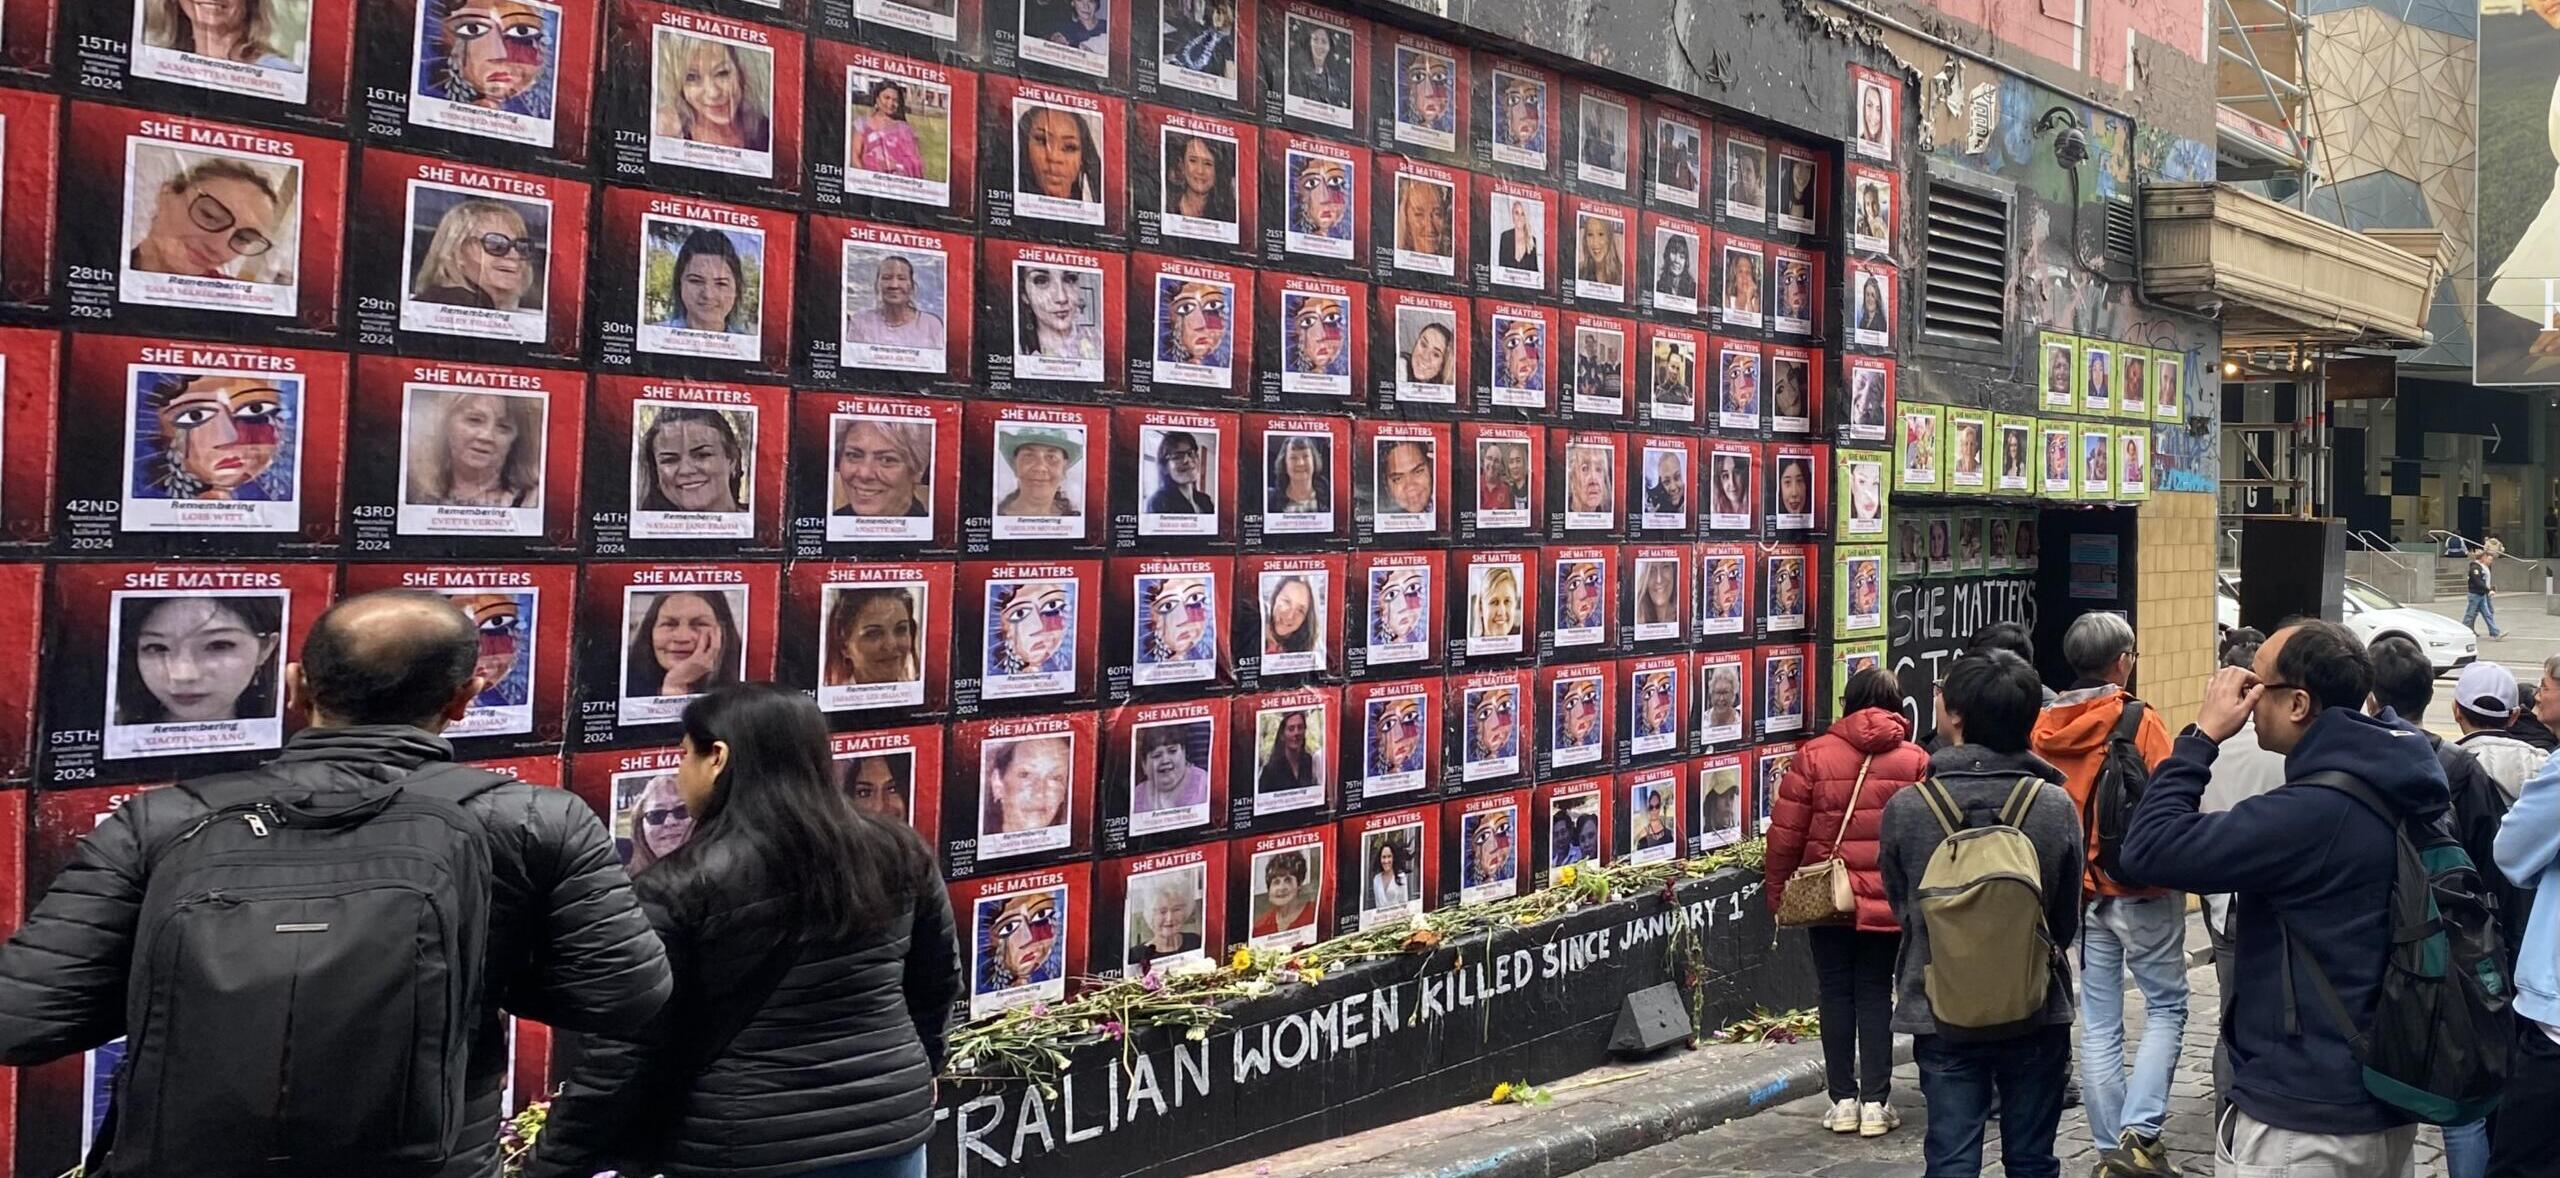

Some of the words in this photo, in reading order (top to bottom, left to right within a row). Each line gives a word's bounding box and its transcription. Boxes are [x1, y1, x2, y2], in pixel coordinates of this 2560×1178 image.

[661, 12, 692, 29] SHE
[696, 18, 768, 44] MATTERS
[78, 35, 127, 54] 15TH
[180, 54, 263, 77] Remembering
[854, 53, 881, 69] SHE
[884, 59, 946, 83] MATTERS
[81, 74, 124, 90] 2024
[366, 86, 407, 103] 16TH
[1018, 86, 1041, 99] SHE
[1044, 91, 1098, 110] MATTERS
[450, 103, 518, 123] Remembering
[368, 123, 402, 137] 2024
[1166, 115, 1185, 127] SHE
[1188, 120, 1234, 136] MATTERS
[141, 120, 187, 140] SHE
[190, 126, 294, 156] MATTERS
[614, 130, 647, 144] 17TH
[1290, 140, 1309, 151] SHE
[1311, 144, 1351, 159] MATTERS
[617, 164, 645, 175] 2024
[814, 163, 842, 176] 18TH
[1399, 162, 1417, 173] SHE
[1419, 165, 1452, 180] MATTERS
[418, 165, 453, 182] SHE
[460, 171, 545, 196] MATTERS
[817, 193, 841, 205] 2024
[987, 189, 1012, 200] 19TH
[651, 200, 681, 216] SHE
[686, 205, 759, 227] MATTERS
[850, 227, 876, 241] SHE
[880, 231, 942, 249] MATTERS
[1018, 249, 1041, 261] SHE
[1044, 253, 1099, 267] MATTERS
[69, 266, 113, 281] 28th
[1161, 263, 1179, 274] SHE
[1184, 269, 1231, 282] MATTERS
[1286, 280, 1304, 290] SHE
[1307, 282, 1346, 295] MATTERS
[359, 297, 395, 310] 29th
[1400, 296, 1415, 305] SHE
[1418, 298, 1453, 309] MATTERS
[70, 305, 112, 318] 2024
[441, 306, 509, 320] Remembering
[602, 322, 633, 334] 30th
[359, 332, 393, 344] 2024
[141, 348, 184, 364] SHE
[188, 351, 295, 371] MATTERS
[603, 354, 631, 365] 2024
[414, 368, 450, 383] SHE
[456, 372, 541, 389] MATTERS
[642, 385, 673, 399] SHE
[678, 389, 751, 403] MATTERS
[837, 401, 863, 414] SHE
[867, 403, 931, 417] MATTERS
[1000, 409, 1024, 420] SHE
[1027, 410, 1082, 423] MATTERS
[1145, 414, 1165, 424] SHE
[1167, 416, 1216, 427] MATTERS
[1268, 420, 1286, 430] SHE
[1289, 421, 1329, 432] MATTERS
[1378, 426, 1394, 435] SHE
[1396, 426, 1432, 436] MATTERS
[66, 500, 119, 512] 42ND
[171, 502, 255, 512] Remembering
[352, 506, 395, 517] 43RD
[438, 508, 506, 517] Remembering
[213, 513, 244, 521] WITT
[593, 513, 628, 523] 44TH
[664, 514, 722, 522] Remembering
[795, 518, 824, 527] 45TH
[965, 518, 991, 526] 46TH
[72, 539, 114, 549] 2024
[356, 540, 391, 550] 2024
[596, 544, 625, 554] 2024
[1472, 554, 1486, 563] SHE
[1488, 553, 1521, 562] MATTERS
[1560, 550, 1571, 558] SHE
[1574, 549, 1603, 558] MATTERS
[1140, 562, 1160, 573] SHE
[1163, 562, 1211, 572] MATTERS
[1264, 561, 1281, 570] SHE
[1284, 560, 1325, 569] MATTERS
[1372, 557, 1388, 566] SHE
[1390, 556, 1427, 565] MATTERS
[402, 573, 438, 585] SHE
[445, 572, 532, 585] MATTERS
[633, 570, 663, 584] SHE
[669, 570, 742, 583] MATTERS
[829, 570, 854, 581] SHE
[858, 569, 923, 580] MATTERS
[992, 566, 1014, 578] SHE
[1018, 566, 1074, 577] MATTERS
[125, 573, 169, 587] SHE
[178, 573, 281, 587] MATTERS
[1892, 585, 1946, 647] SHE
[1556, 670, 1569, 679] SHE
[1571, 667, 1601, 676] MATTERS
[1468, 678, 1481, 687] SHE
[1484, 674, 1518, 685] MATTERS
[1369, 687, 1385, 697] SHE
[1387, 683, 1424, 695] MATTERS
[582, 702, 616, 712] 57TH
[1137, 710, 1157, 721] SHE
[1160, 706, 1209, 718] MATTERS
[153, 722, 238, 733] Remembering
[988, 723, 1012, 737] SHE
[1016, 720, 1070, 734] MATTERS
[51, 730, 100, 743] 55TH
[209, 732, 245, 742] WANG
[583, 732, 613, 743] 2024
[847, 735, 911, 752] MATTERS
[620, 754, 652, 770] SHE
[54, 769, 96, 781] 2024
[1553, 786, 1565, 795] SHE
[1567, 781, 1598, 794] MATTERS
[1465, 802, 1479, 812] SHE
[1481, 796, 1515, 810] MATTERS
[1365, 818, 1382, 830] SHE
[1384, 811, 1421, 828] MATTERS
[950, 839, 976, 850] 72ND
[1256, 839, 1275, 851] SHE
[1278, 832, 1320, 847] MATTERS
[1132, 859, 1155, 872] SHE
[1158, 851, 1203, 867] MATTERS
[981, 880, 1006, 895] SHE
[1009, 873, 1064, 892] MATTERS
[935, 1039, 1210, 1177] RALIAN
[1233, 985, 1399, 1084] WOMEN
[1420, 949, 1533, 1023] KILLED
[1542, 931, 1610, 979] SINCE
[1619, 898, 1717, 951] JANUARY
